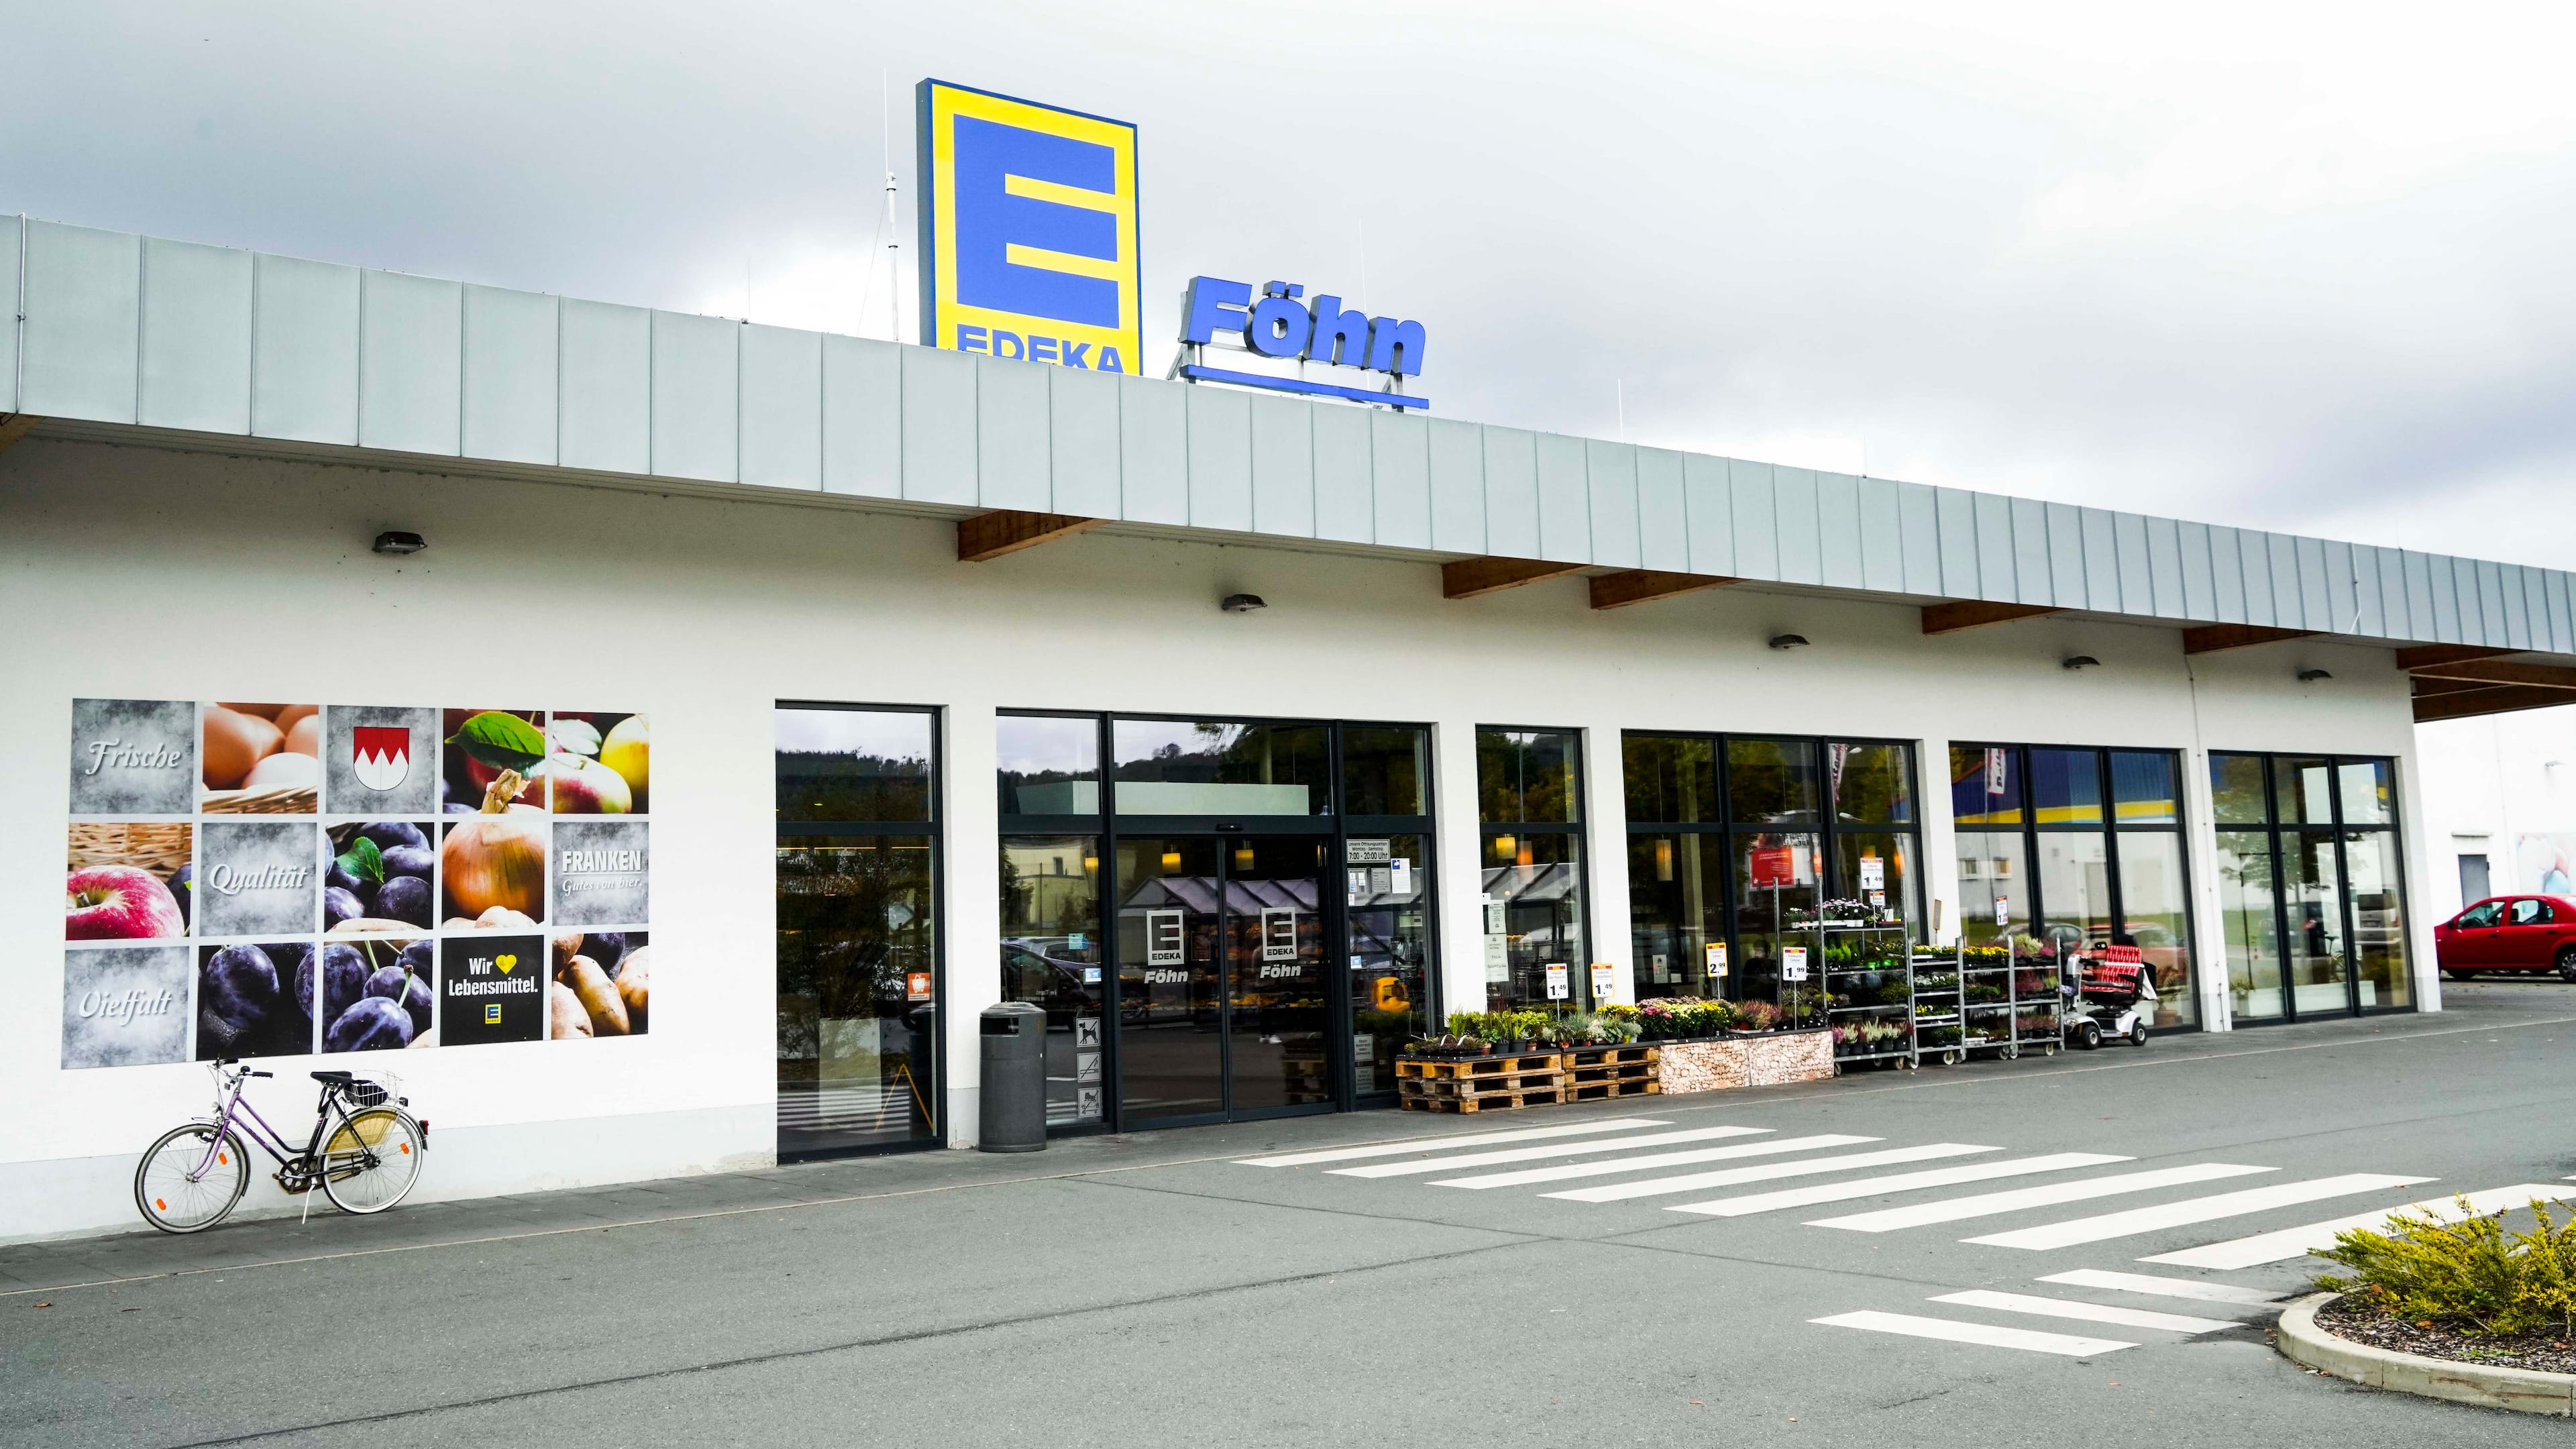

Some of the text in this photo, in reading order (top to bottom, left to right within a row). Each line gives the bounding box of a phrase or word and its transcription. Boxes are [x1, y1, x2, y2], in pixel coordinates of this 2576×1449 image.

[1178, 276, 1426, 378] Föhn
[957, 323, 1124, 374] EDEKA
[85, 738, 182, 775] Frische
[562, 850, 642, 871] FRANKEN
[209, 863, 308, 896] Qualität
[562, 876, 643, 897] Gutes von hier.
[1152, 953, 1181, 961] EDEKA
[1267, 948, 1294, 956] EDEKA
[469, 957, 493, 975] Wir
[1144, 969, 1189, 984] Föhn
[1260, 964, 1301, 978] Föhn
[448, 976, 539, 997] Lebensmittel.
[78, 987, 172, 1026] Vielfalt
